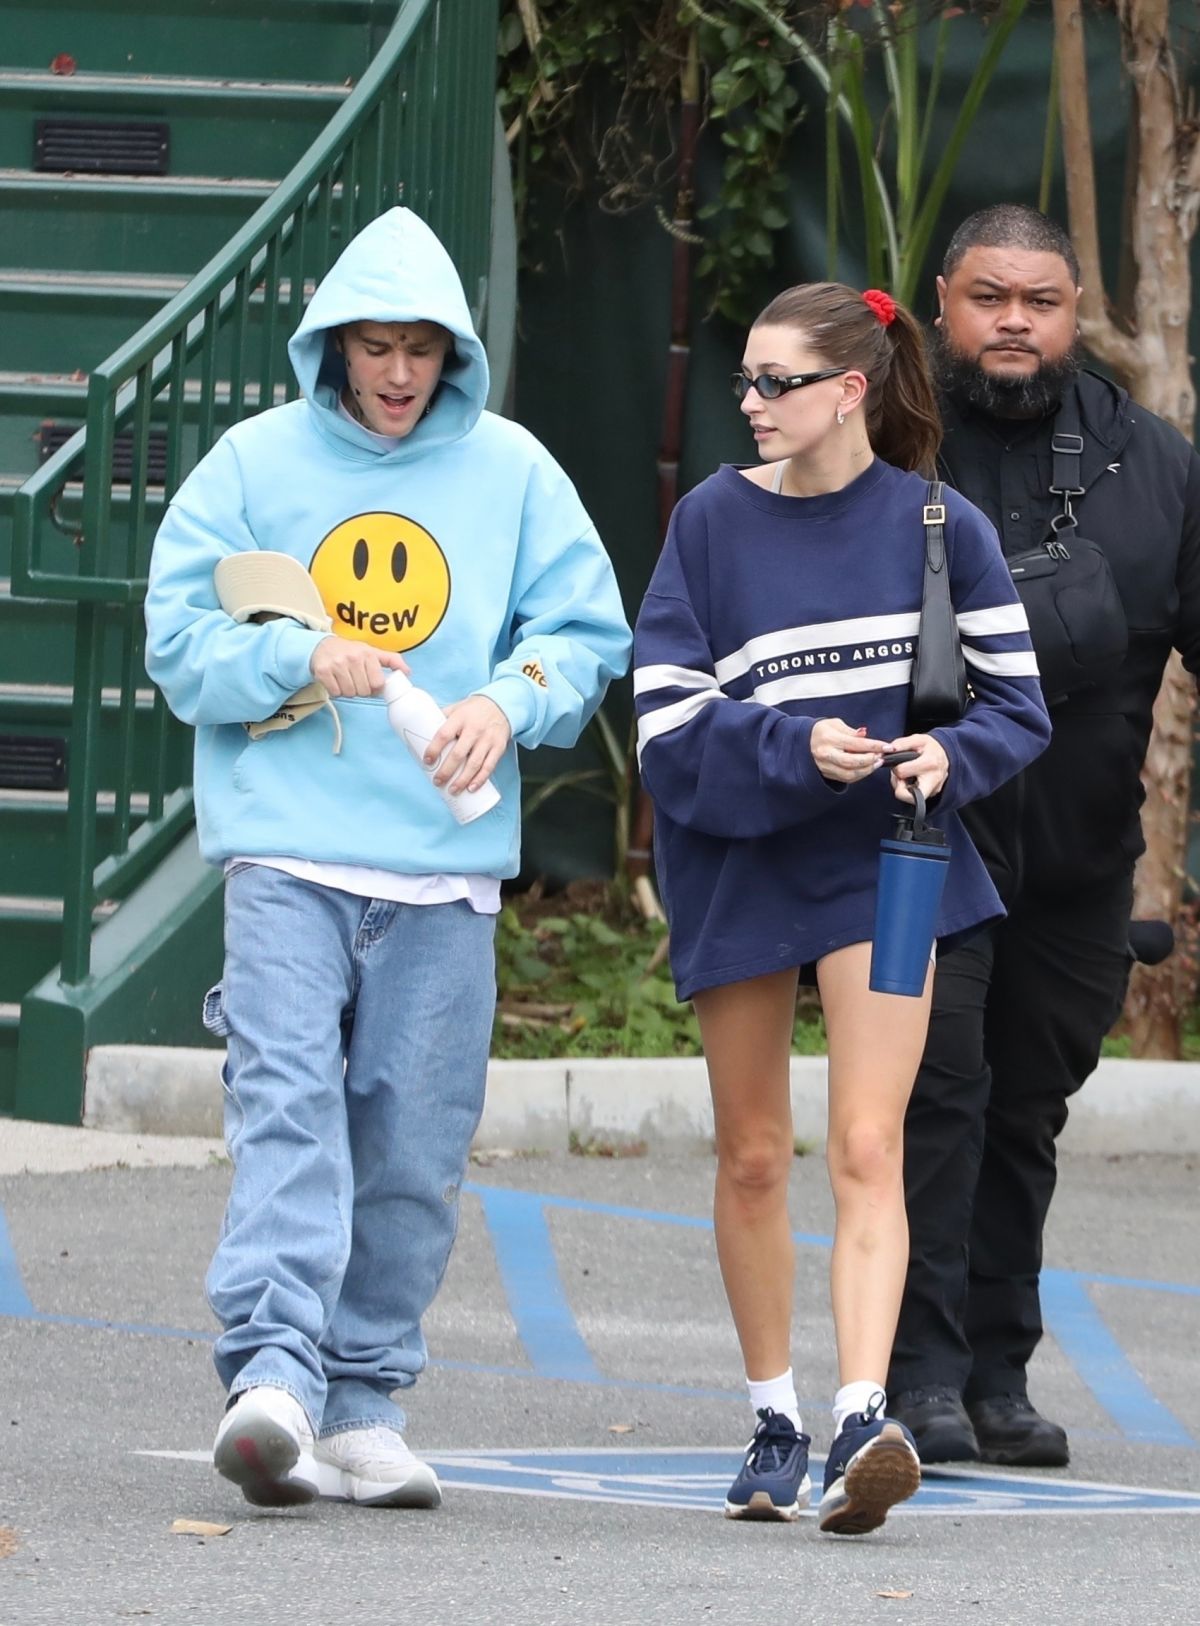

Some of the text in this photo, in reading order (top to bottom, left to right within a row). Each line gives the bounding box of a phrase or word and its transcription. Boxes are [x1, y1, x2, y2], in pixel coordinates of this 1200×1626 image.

[336, 601, 419, 634] drew
[756, 642, 912, 677] TORONTO ARGOS
